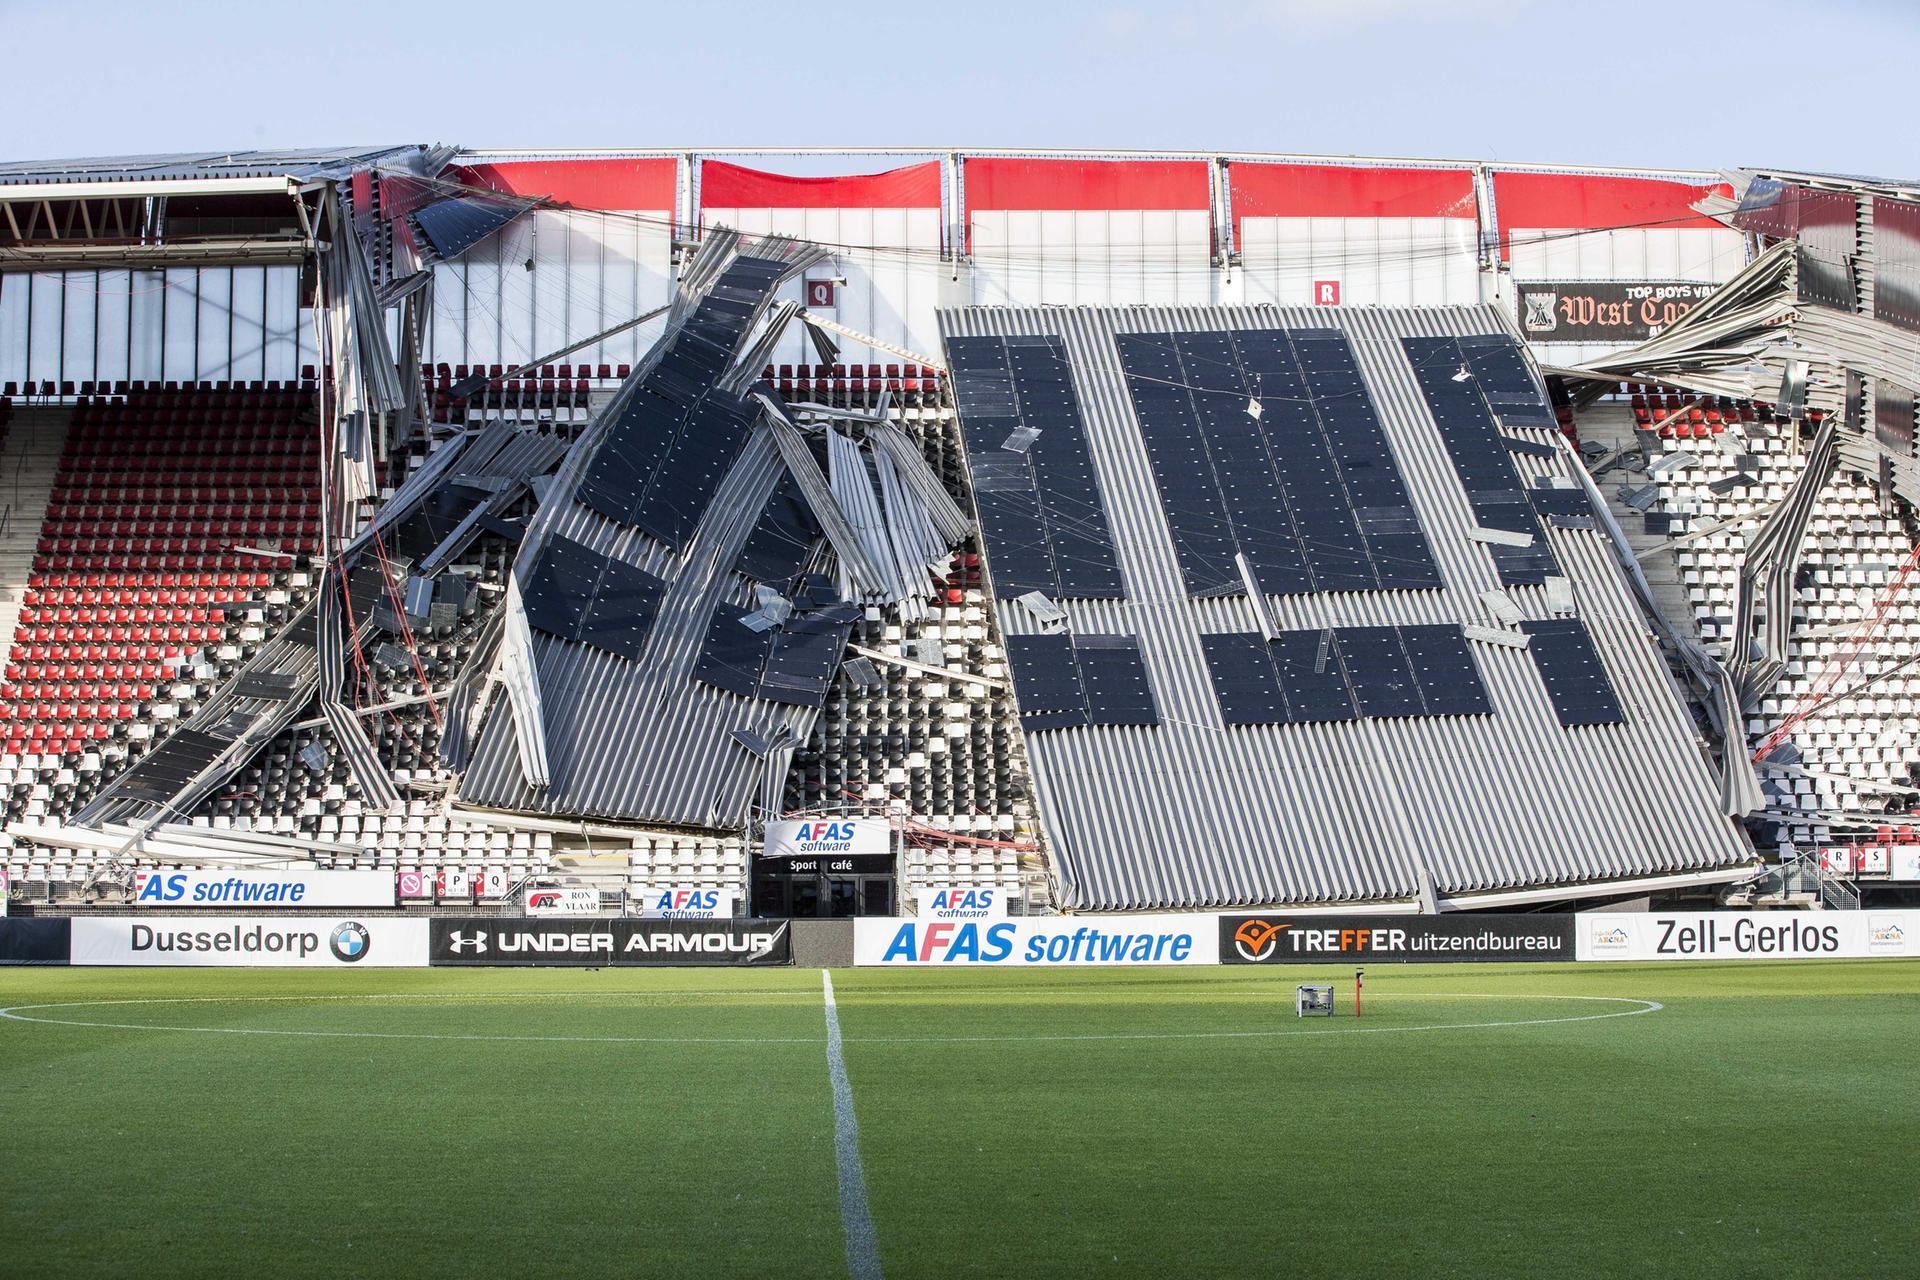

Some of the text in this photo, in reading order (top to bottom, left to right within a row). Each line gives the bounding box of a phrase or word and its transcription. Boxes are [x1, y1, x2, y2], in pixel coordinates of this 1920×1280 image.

[814, 285, 827, 305] Q
[1321, 284, 1334, 302] R
[1626, 287, 1652, 299] TOP
[1656, 286, 1691, 298] BOYS
[1560, 296, 1633, 325] West
[795, 822, 855, 841] AFAS
[800, 841, 850, 851] software
[1836, 852, 1842, 861] R
[1873, 851, 1879, 861] S
[791, 860, 852, 872] Sport café
[193, 878, 305, 901] software
[454, 876, 460, 885] P
[492, 876, 499, 886] Q
[537, 896, 558, 908] AZ
[656, 891, 719, 909] AFAS
[931, 890, 994, 909] AFAS
[662, 909, 713, 919] software
[937, 908, 989, 917] software
[333, 922, 368, 936] BMW
[1656, 918, 1839, 954] Zell-Gerlos
[131, 925, 319, 958] Dusseldorp
[499, 933, 773, 952] UNDER ARMOUR
[882, 923, 1193, 962] AFAS software
[1287, 929, 1562, 951] TREFFER uitzendbureau
